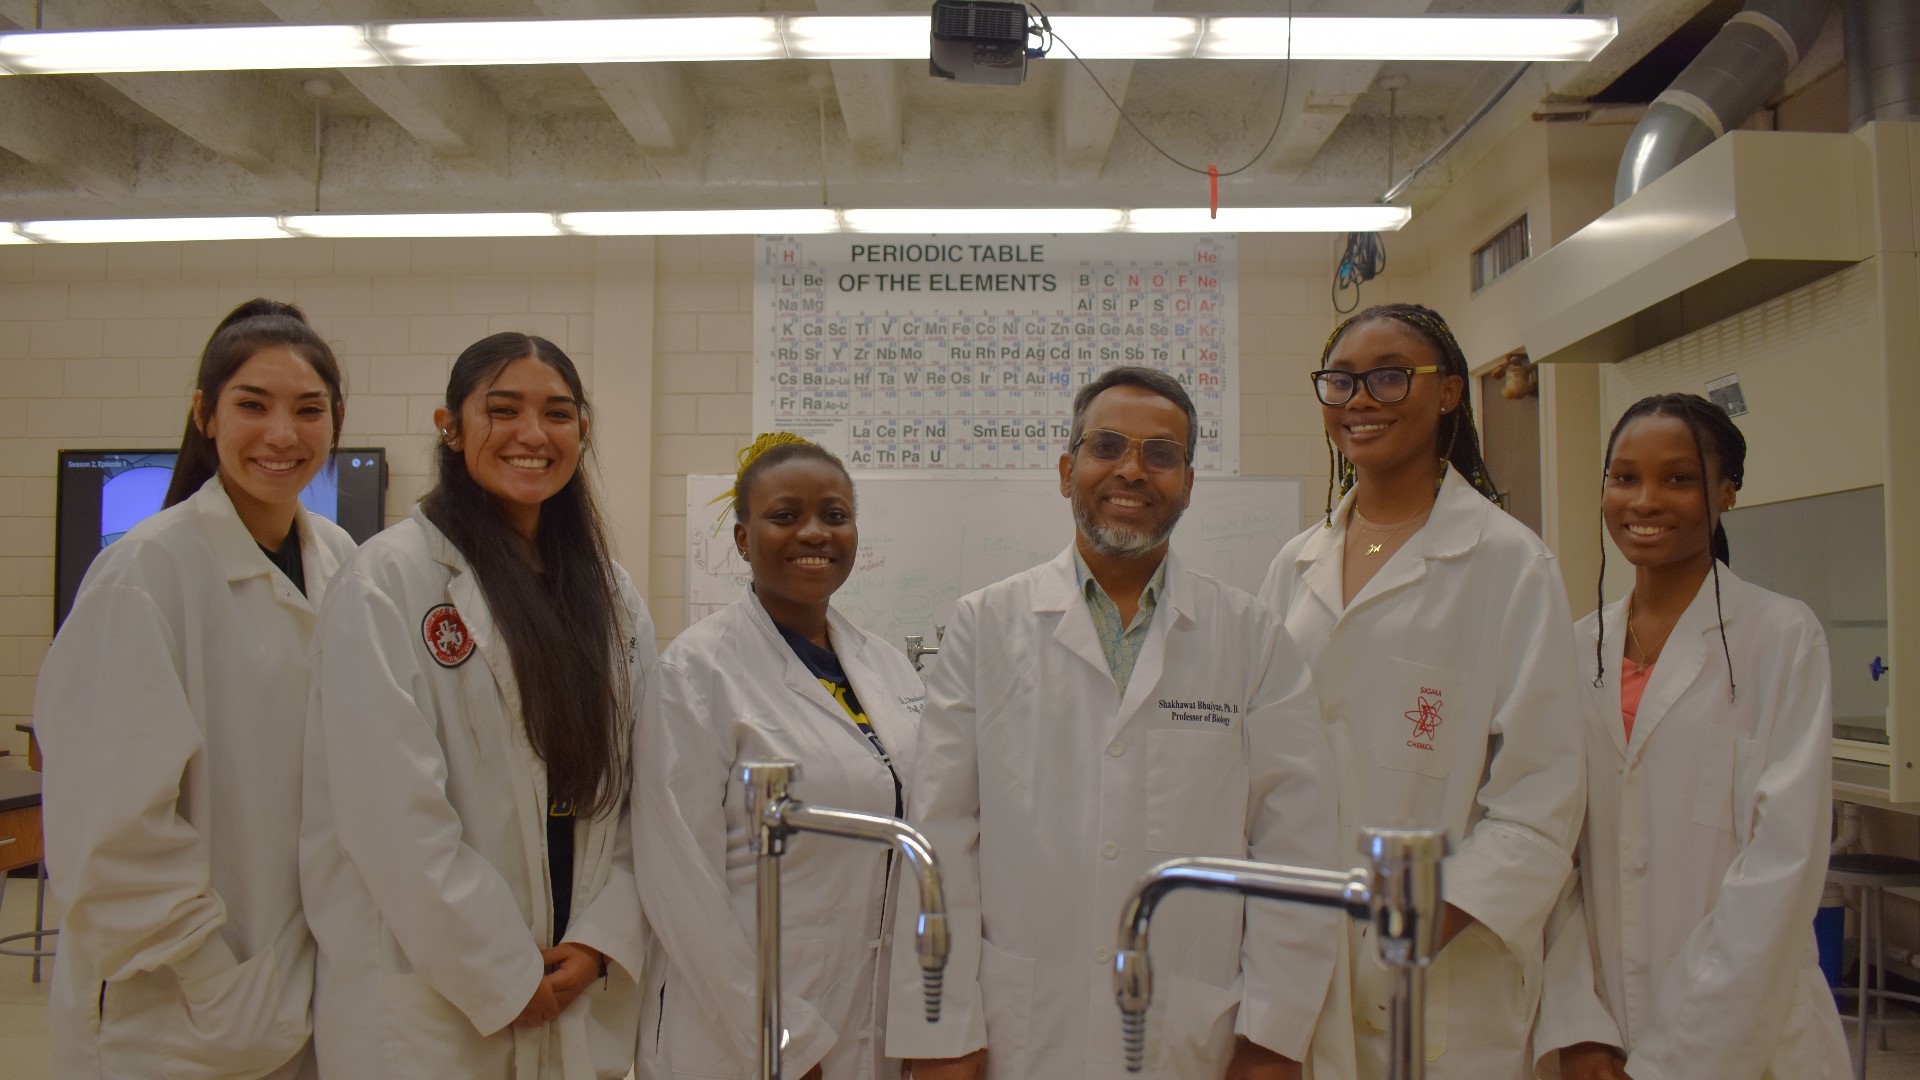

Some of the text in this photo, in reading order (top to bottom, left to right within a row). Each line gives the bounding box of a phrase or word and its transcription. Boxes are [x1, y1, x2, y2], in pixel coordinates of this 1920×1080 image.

[784, 251, 793, 262] H
[852, 245, 1044, 262] PERIODIC TABLE
[1197, 252, 1216, 263] He
[782, 275, 795, 286] Li
[804, 275, 823, 286] Be
[838, 274, 1057, 292] OF THE ELEMENTS
[1080, 275, 1089, 286] B
[1104, 275, 1114, 286] C
[1129, 276, 1139, 286] N
[1153, 275, 1164, 286] O
[1178, 276, 1186, 286] F
[1198, 276, 1217, 287] Ne
[779, 299, 798, 311] Na
[802, 299, 824, 313] Mg
[1078, 300, 1092, 310] Al
[1103, 299, 1116, 310] Si
[1130, 300, 1139, 310] P
[1154, 300, 1164, 311] S
[1176, 300, 1190, 311] Cl
[1200, 301, 1216, 311] Ar
[783, 324, 793, 335] K
[803, 324, 822, 336] Ca
[828, 323, 847, 336] Sc
[882, 323, 892, 335] V
[903, 323, 920, 335] Cr
[925, 323, 947, 335] Mn
[952, 323, 970, 335] Fe
[975, 322, 996, 335] Co
[1025, 323, 1045, 335] Cu
[1050, 323, 1069, 335] Zn
[1075, 323, 1095, 335] Ga
[1100, 323, 1120, 335] Ge
[1125, 324, 1144, 335] As
[1150, 324, 1168, 335] Se
[1175, 324, 1191, 335] Br
[1200, 324, 1217, 336] Kr
[778, 348, 798, 360] Rb
[805, 348, 821, 360] Sr
[832, 348, 842, 360] Y
[854, 348, 869, 360] Zr
[877, 348, 897, 360] Nb
[901, 348, 922, 360] Mo
[952, 348, 971, 359] Ru
[976, 348, 995, 359] Rh
[1001, 348, 1020, 359] Pd
[1025, 348, 1045, 362] Ag
[1050, 348, 1070, 359] Cd
[1078, 348, 1091, 359] In
[1100, 348, 1119, 360] Sn
[1125, 348, 1144, 360] Sb
[1151, 349, 1168, 360] Te
[1200, 349, 1217, 361] Xe
[778, 373, 798, 385] Cs
[803, 373, 822, 385] Ba
[854, 372, 870, 384] Hf
[879, 372, 894, 385] Ta
[904, 372, 918, 384] W
[926, 372, 946, 384] Re
[951, 372, 971, 385] Os
[981, 372, 991, 384] Ir
[1003, 372, 1019, 384] Pt
[1025, 372, 1045, 384] Au
[1050, 372, 1069, 385] Hg
[1178, 374, 1192, 385] At
[1199, 373, 1218, 385] Rn
[780, 398, 795, 409] Fr
[803, 397, 822, 410] Ra
[853, 426, 870, 438] La
[876, 426, 896, 438] Ce
[903, 426, 919, 438] Pr
[926, 426, 946, 438] Nd
[974, 426, 997, 438] Sm
[1001, 426, 1020, 437] Eu
[1025, 426, 1045, 438] Gd
[1050, 426, 1069, 437] Tb
[1201, 427, 1218, 438] Lu
[852, 451, 870, 463] Ac
[876, 450, 895, 463] Th
[902, 450, 920, 463] Pa
[931, 450, 940, 463] U
[1420, 686, 1442, 696] SIGMA
[1158, 700, 1195, 709] Shakhawat
[1172, 712, 1230, 726] Professor of Biology
